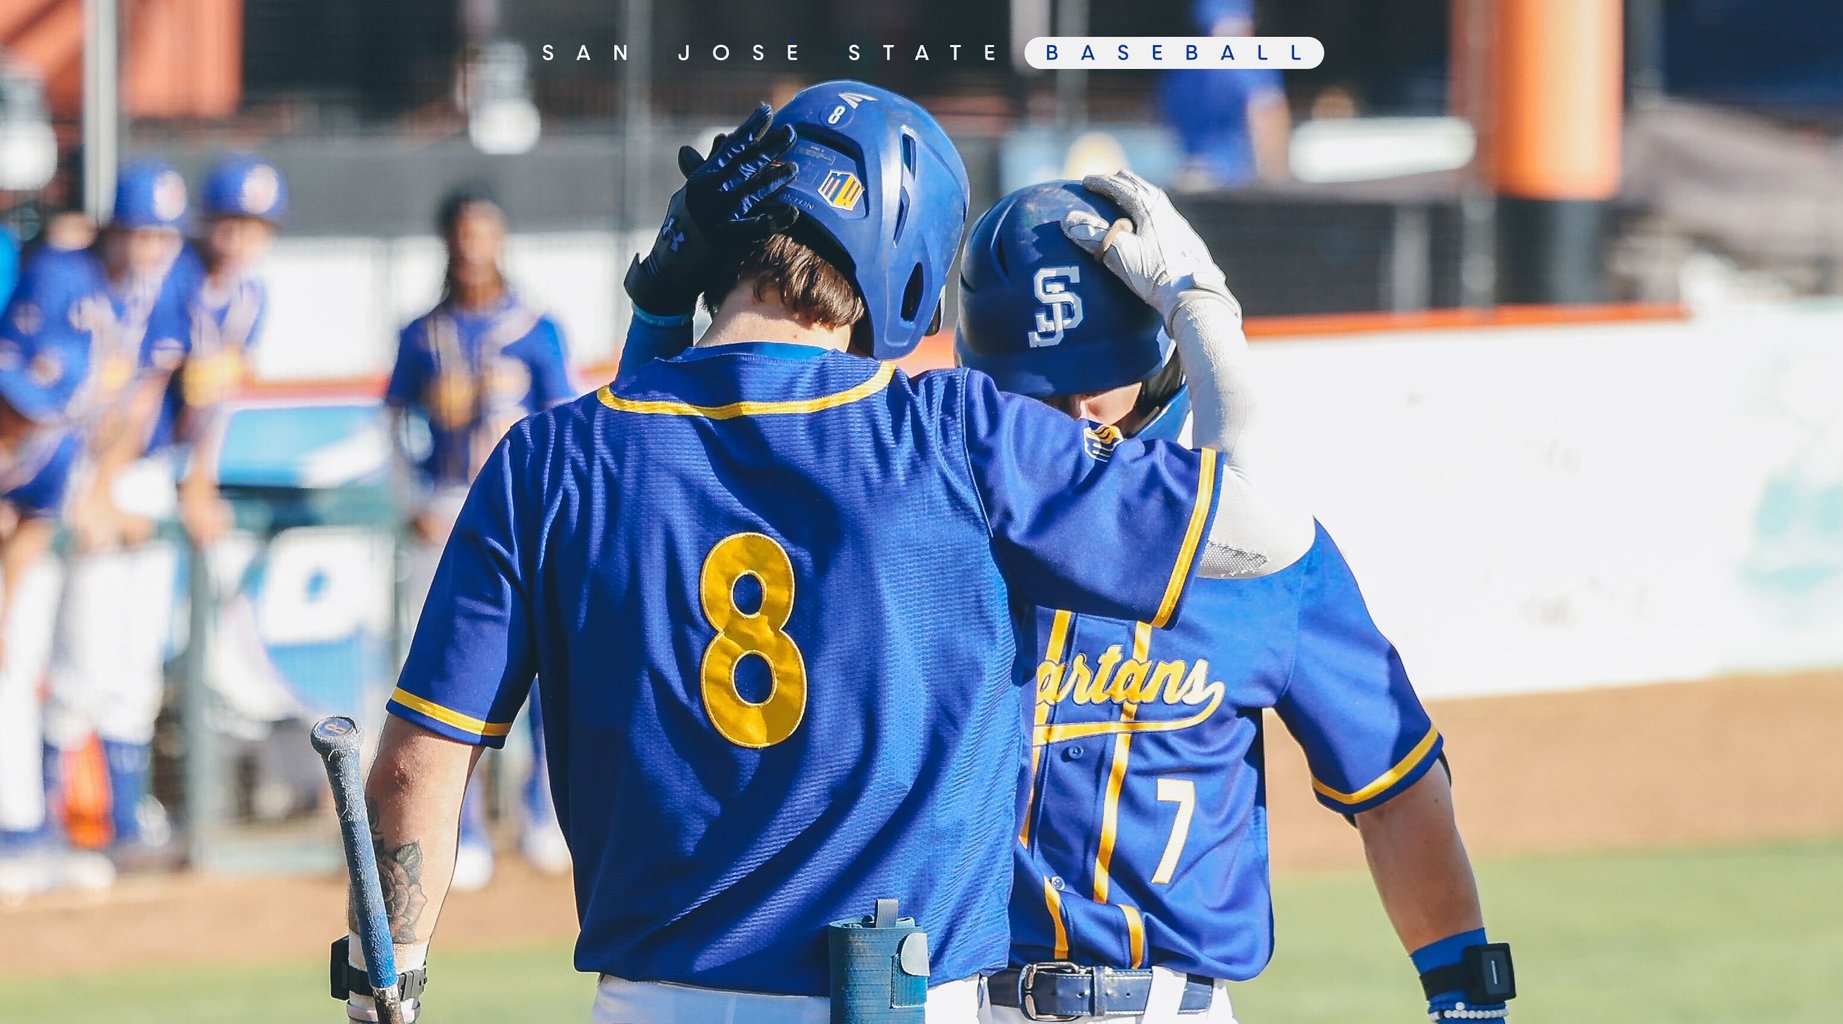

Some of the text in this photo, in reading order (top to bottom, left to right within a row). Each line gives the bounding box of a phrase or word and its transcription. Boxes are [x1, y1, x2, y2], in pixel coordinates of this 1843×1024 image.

[827, 105, 847, 125] 8
[700, 531, 808, 750] 8
[1151, 777, 1196, 885] 7
